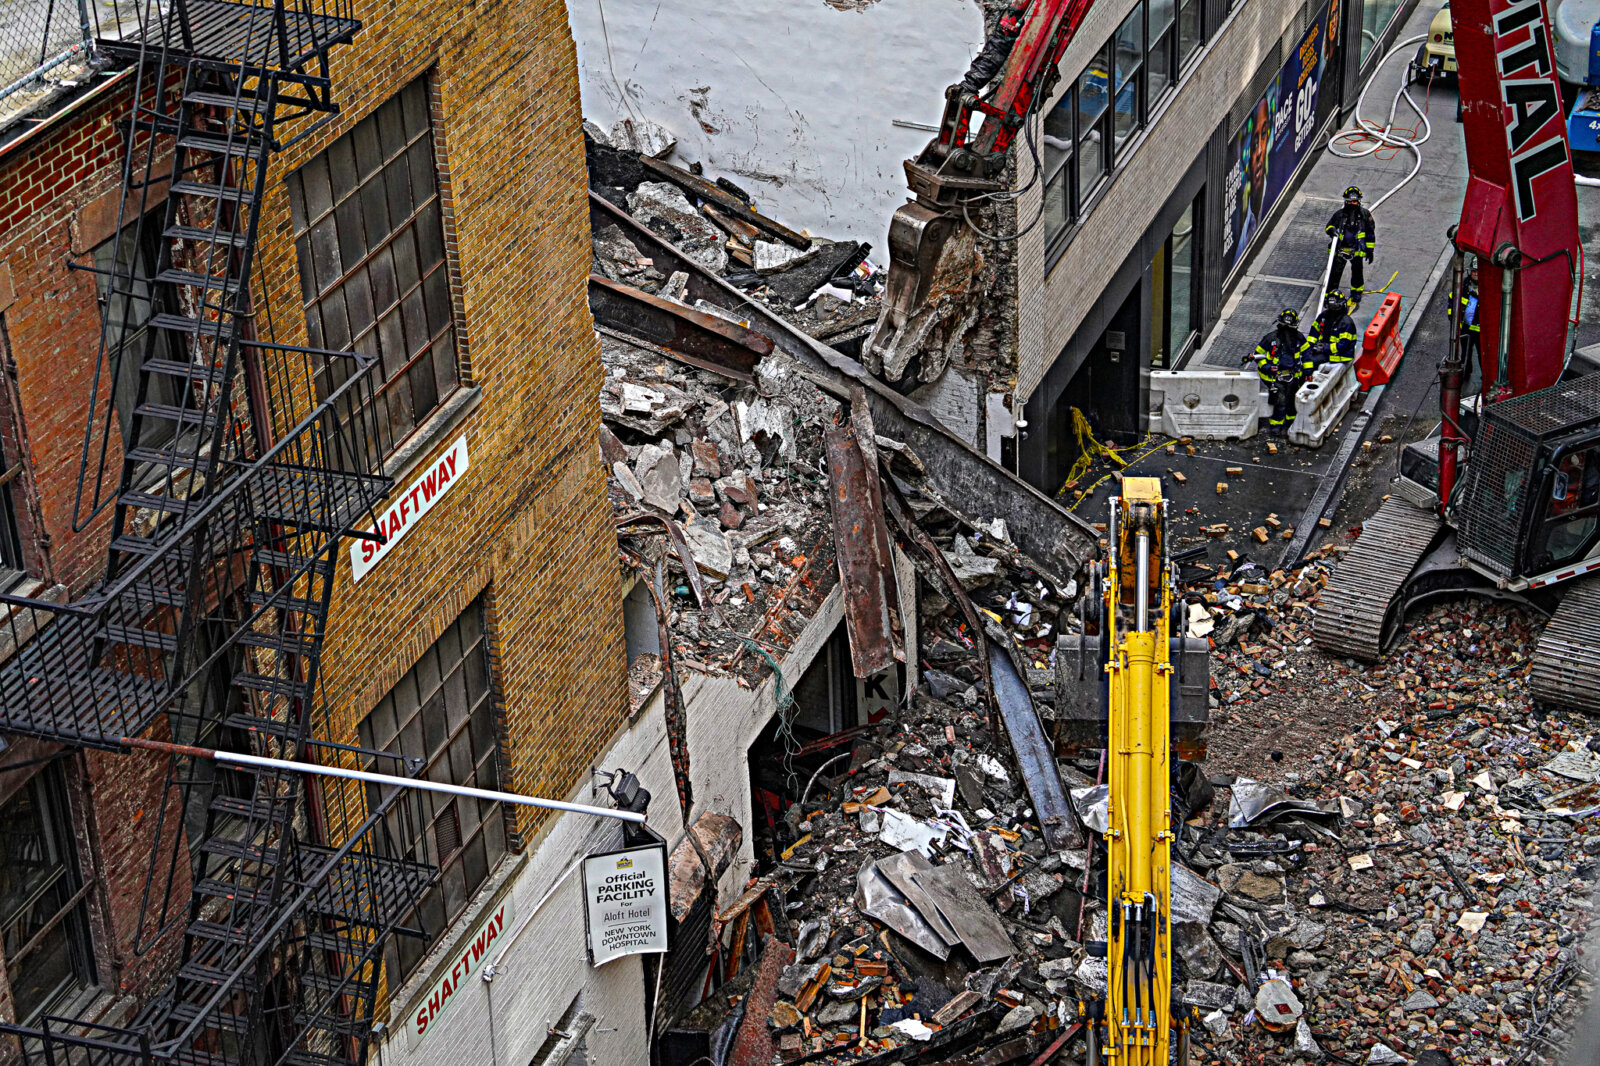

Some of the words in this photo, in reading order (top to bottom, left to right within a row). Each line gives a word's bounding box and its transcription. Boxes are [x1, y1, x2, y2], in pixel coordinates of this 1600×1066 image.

[1274, 91, 1293, 135] PACE
[1493, 0, 1569, 223] ITAL
[605, 871, 646, 884] Official
[598, 879, 654, 894] PARKING
[596, 888, 656, 904] FACILITY
[604, 911, 625, 923] Aloft
[628, 907, 650, 918] Hotel
[601, 931, 657, 947] DOWNTOWN
[604, 927, 625, 938] NEW
[627, 924, 652, 933] YORK
[609, 938, 649, 951] HOSPITAL
[416, 904, 505, 1035] SHAFTWAY
